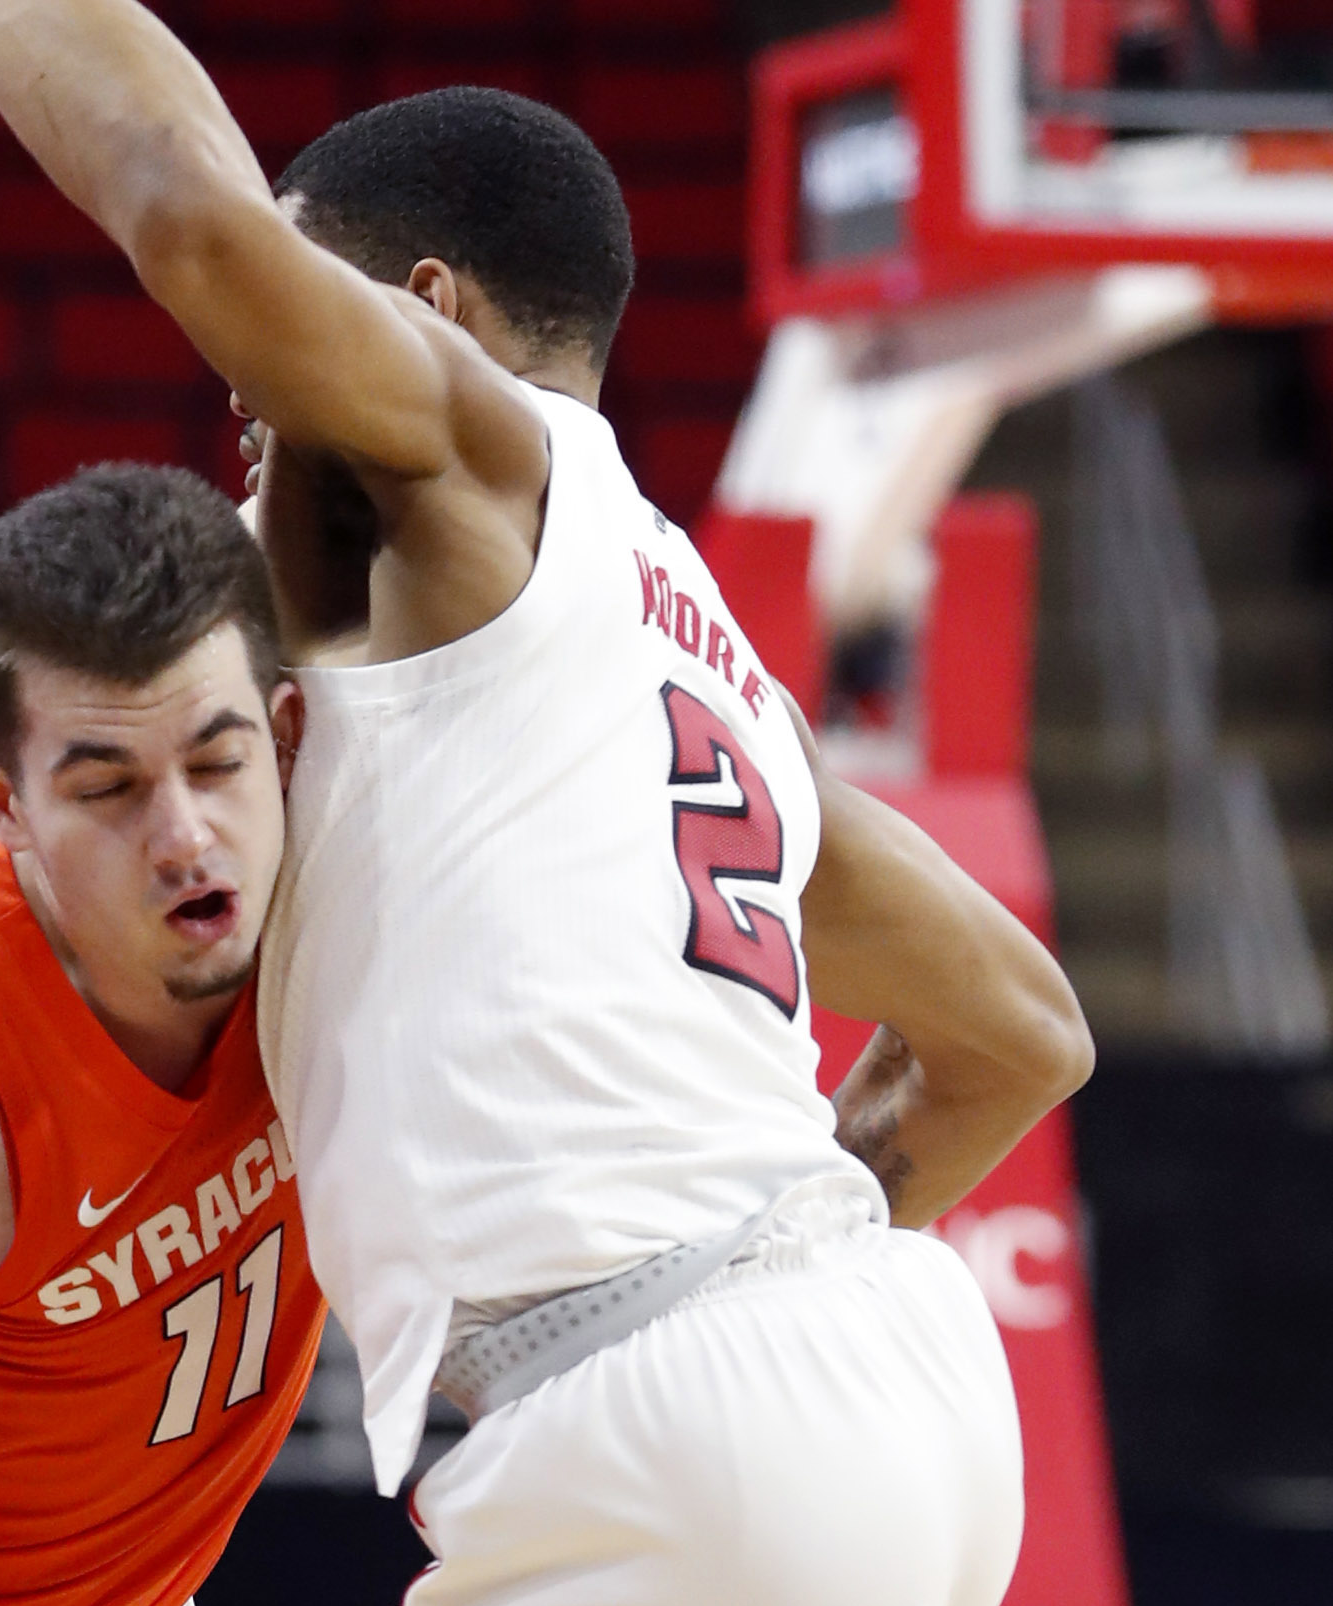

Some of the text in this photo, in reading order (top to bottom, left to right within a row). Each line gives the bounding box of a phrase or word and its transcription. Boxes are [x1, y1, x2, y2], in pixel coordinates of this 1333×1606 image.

[633, 549, 771, 721] MOORE
[659, 680, 800, 1024] 2
[146, 1221, 285, 1447] 11
